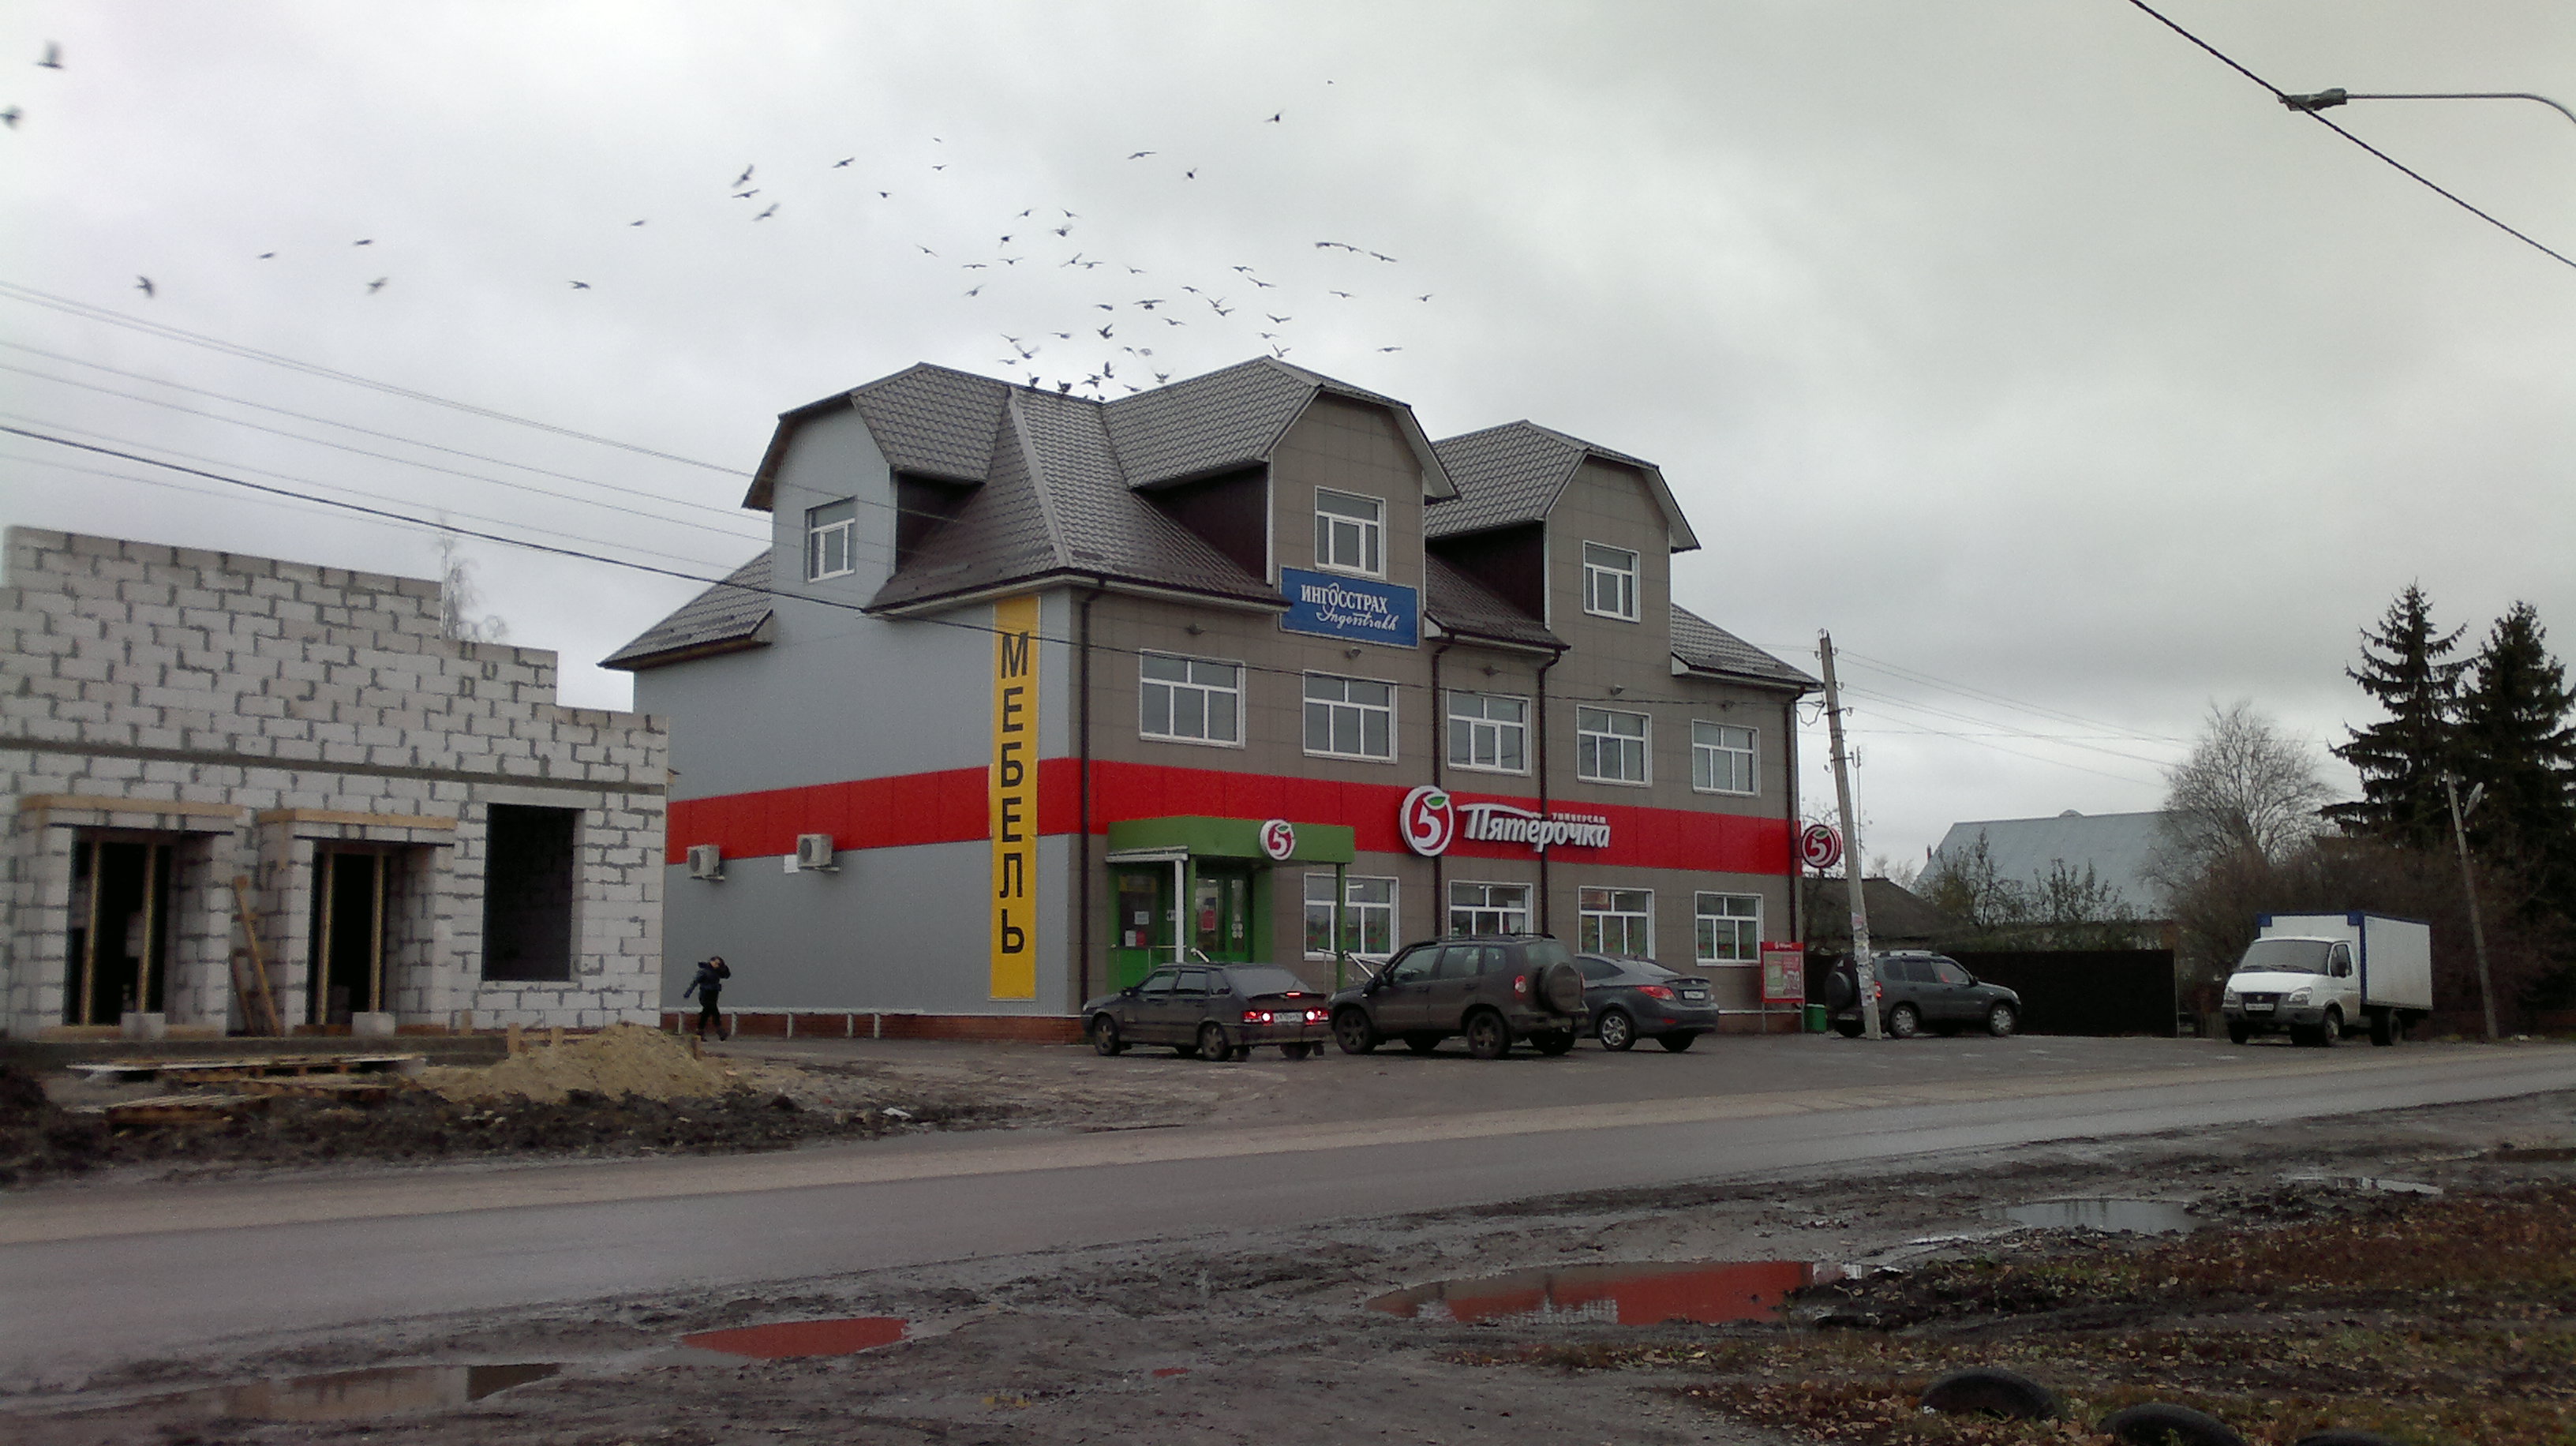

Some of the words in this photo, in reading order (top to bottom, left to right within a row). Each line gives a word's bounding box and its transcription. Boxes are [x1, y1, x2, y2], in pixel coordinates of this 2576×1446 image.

[1300, 582, 1389, 615] ИНГОССТРАХ
[998, 631, 1029, 955] МЕБЕЛЬ
[1455, 802, 1611, 853] Пятерочка
